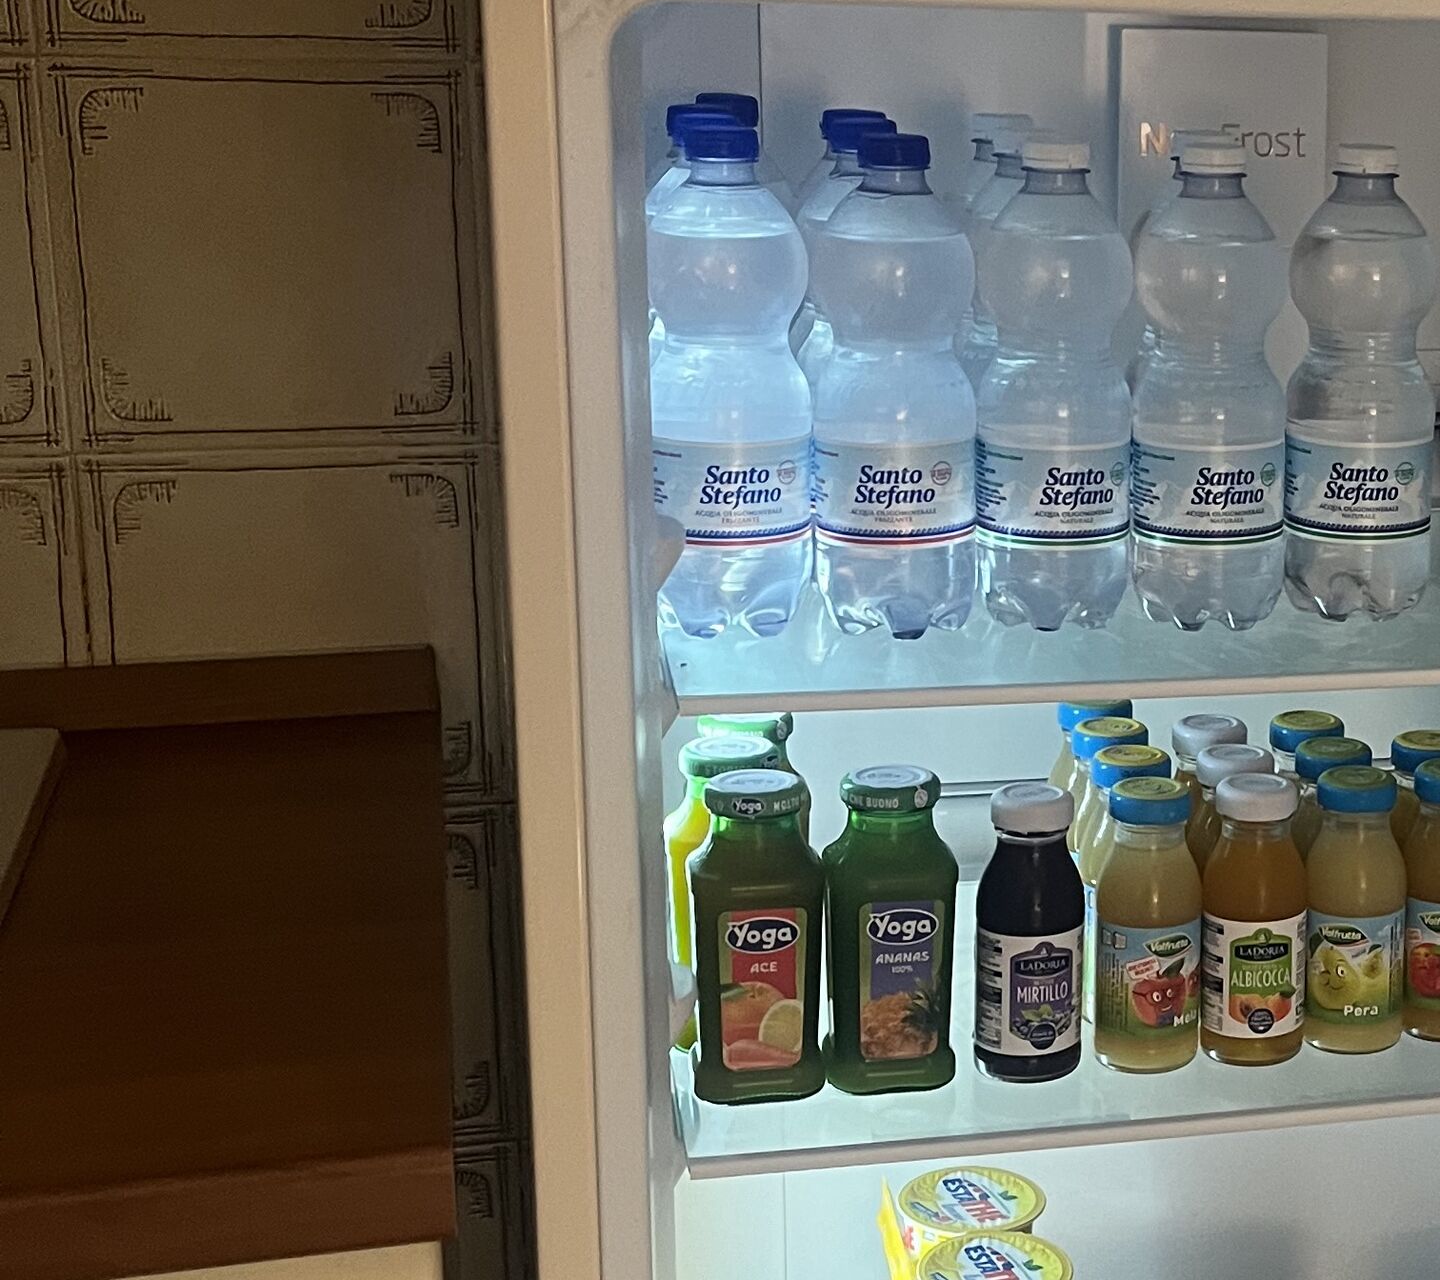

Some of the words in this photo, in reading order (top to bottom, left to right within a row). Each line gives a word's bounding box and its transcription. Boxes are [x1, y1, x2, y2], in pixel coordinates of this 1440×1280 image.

[704, 465, 770, 485] Santo
[859, 465, 922, 485] Santo
[1045, 468, 1105, 486] Santo
[1196, 468, 1255, 486] Santo
[1330, 463, 1388, 482] Santo
[700, 485, 781, 509] Stefano
[855, 485, 935, 509] Stefano
[1039, 487, 1113, 510] Stefano
[1191, 487, 1263, 510] Stefano
[1324, 481, 1398, 505] Stefano
[733, 799, 762, 814] Yoga
[733, 923, 793, 950] Yoga
[874, 915, 932, 940] Yoga
[750, 962, 778, 973] ACE
[875, 951, 930, 964] ANANAS
[1231, 968, 1290, 988] ALBICOCCA
[1017, 981, 1068, 1003] MIRTILLO
[1343, 1005, 1379, 1017] Pera
